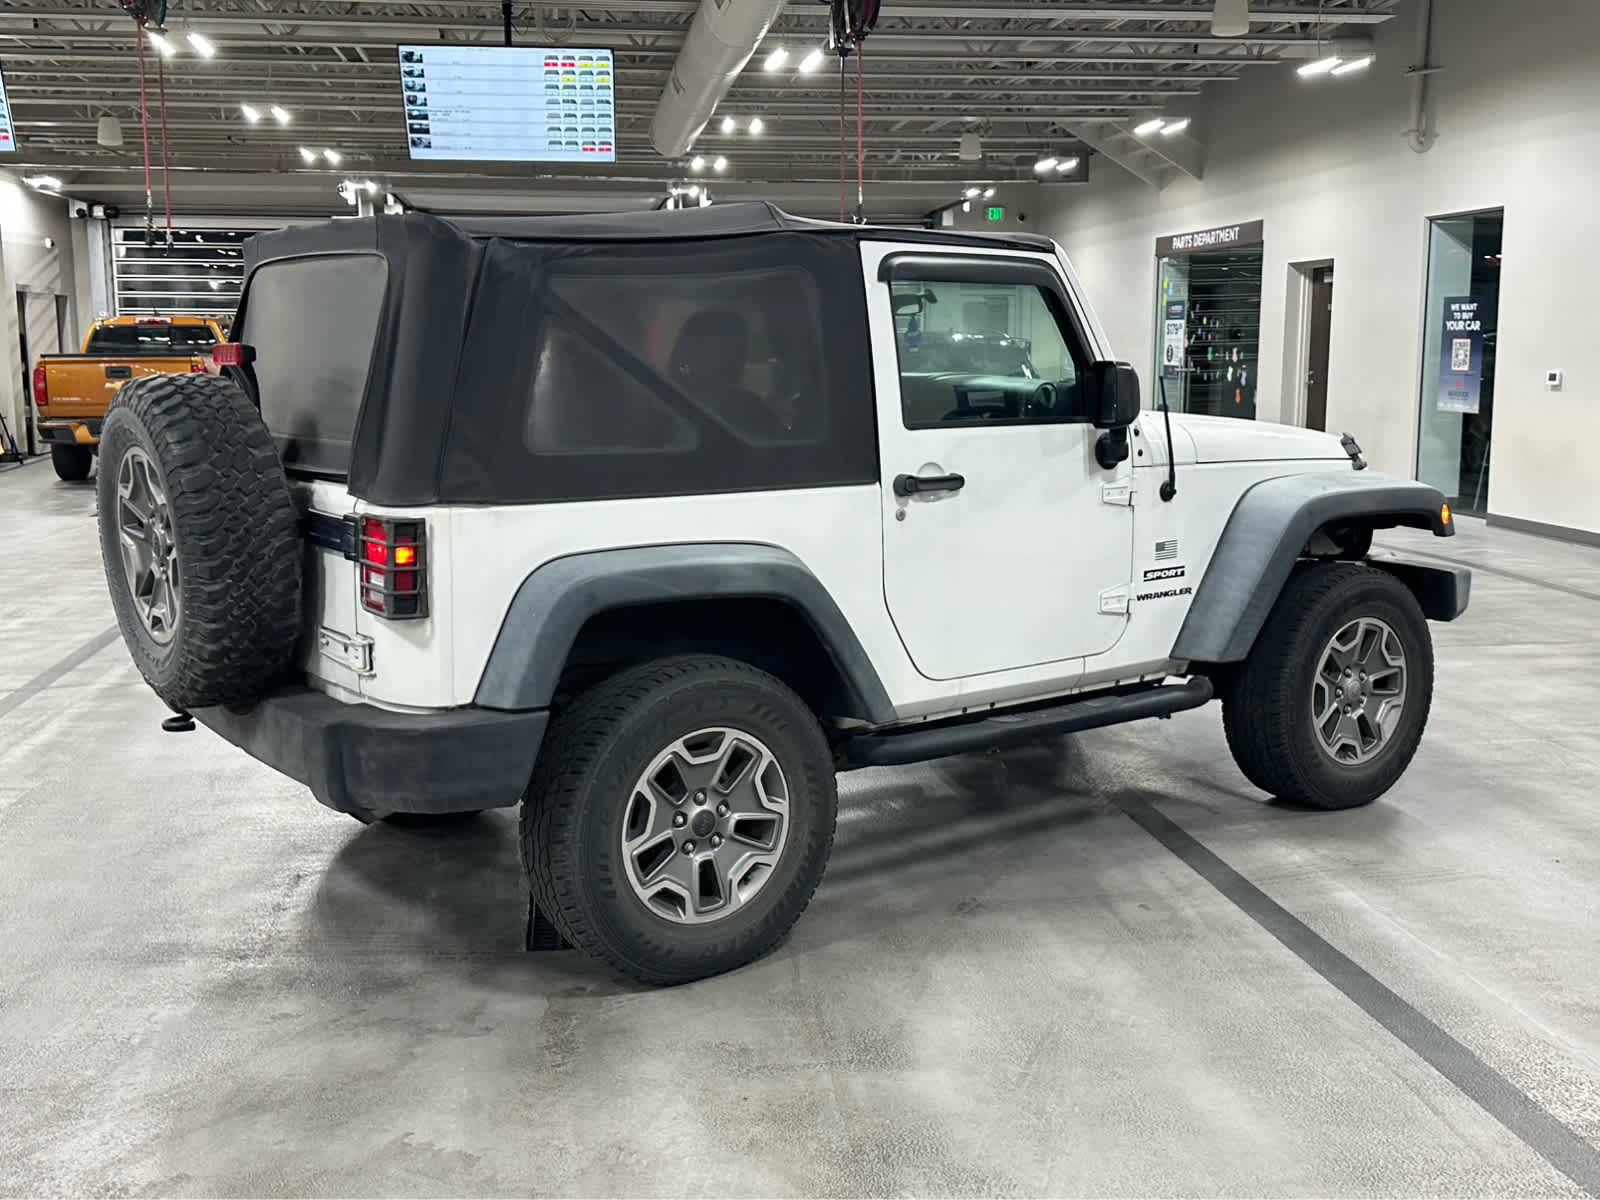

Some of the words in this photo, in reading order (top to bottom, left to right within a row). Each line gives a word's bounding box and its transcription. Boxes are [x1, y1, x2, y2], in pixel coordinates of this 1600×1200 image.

[1172, 234, 1193, 249] PARTS
[1193, 226, 1240, 247] DEPARTMENT
[1450, 303, 1460, 311] WE
[1461, 303, 1478, 311] WANT
[1453, 312, 1461, 320] TO
[1462, 312, 1474, 320] BUY
[1446, 320, 1465, 331] YOUR
[1465, 320, 1481, 331] CAR
[1145, 568, 1184, 580] SPORT
[1136, 587, 1192, 601] WRANGLER
